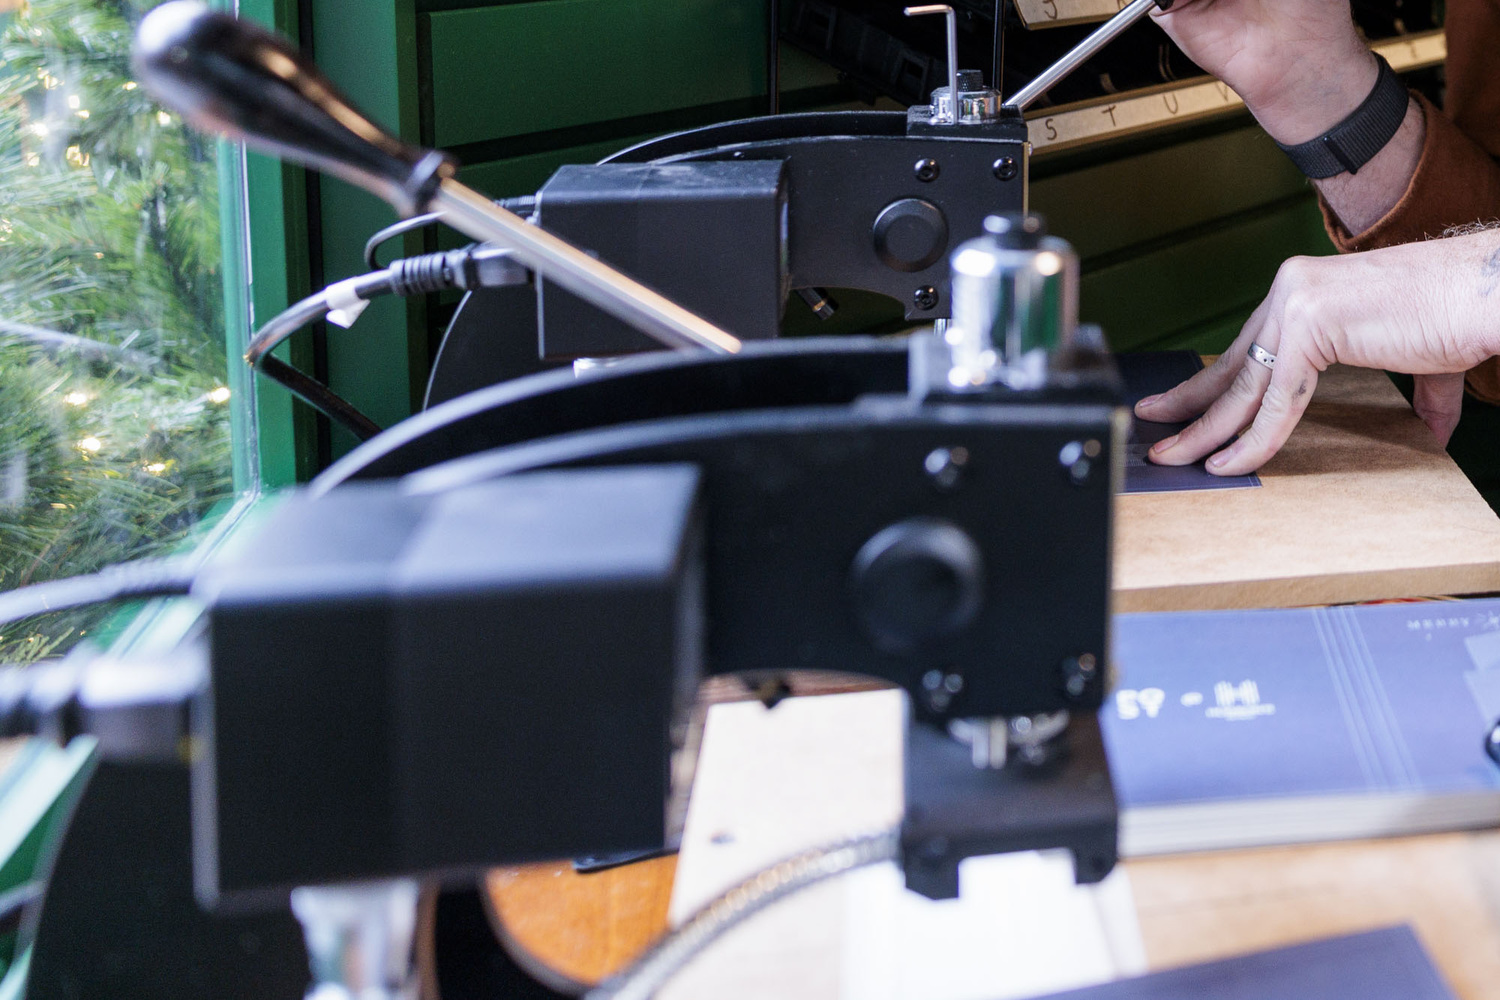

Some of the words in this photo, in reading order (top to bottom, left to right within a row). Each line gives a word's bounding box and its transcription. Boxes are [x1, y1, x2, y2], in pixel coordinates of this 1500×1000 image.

[1045, 118, 1057, 141] S
[1101, 105, 1117, 127] T
[1163, 93, 1178, 115] U
